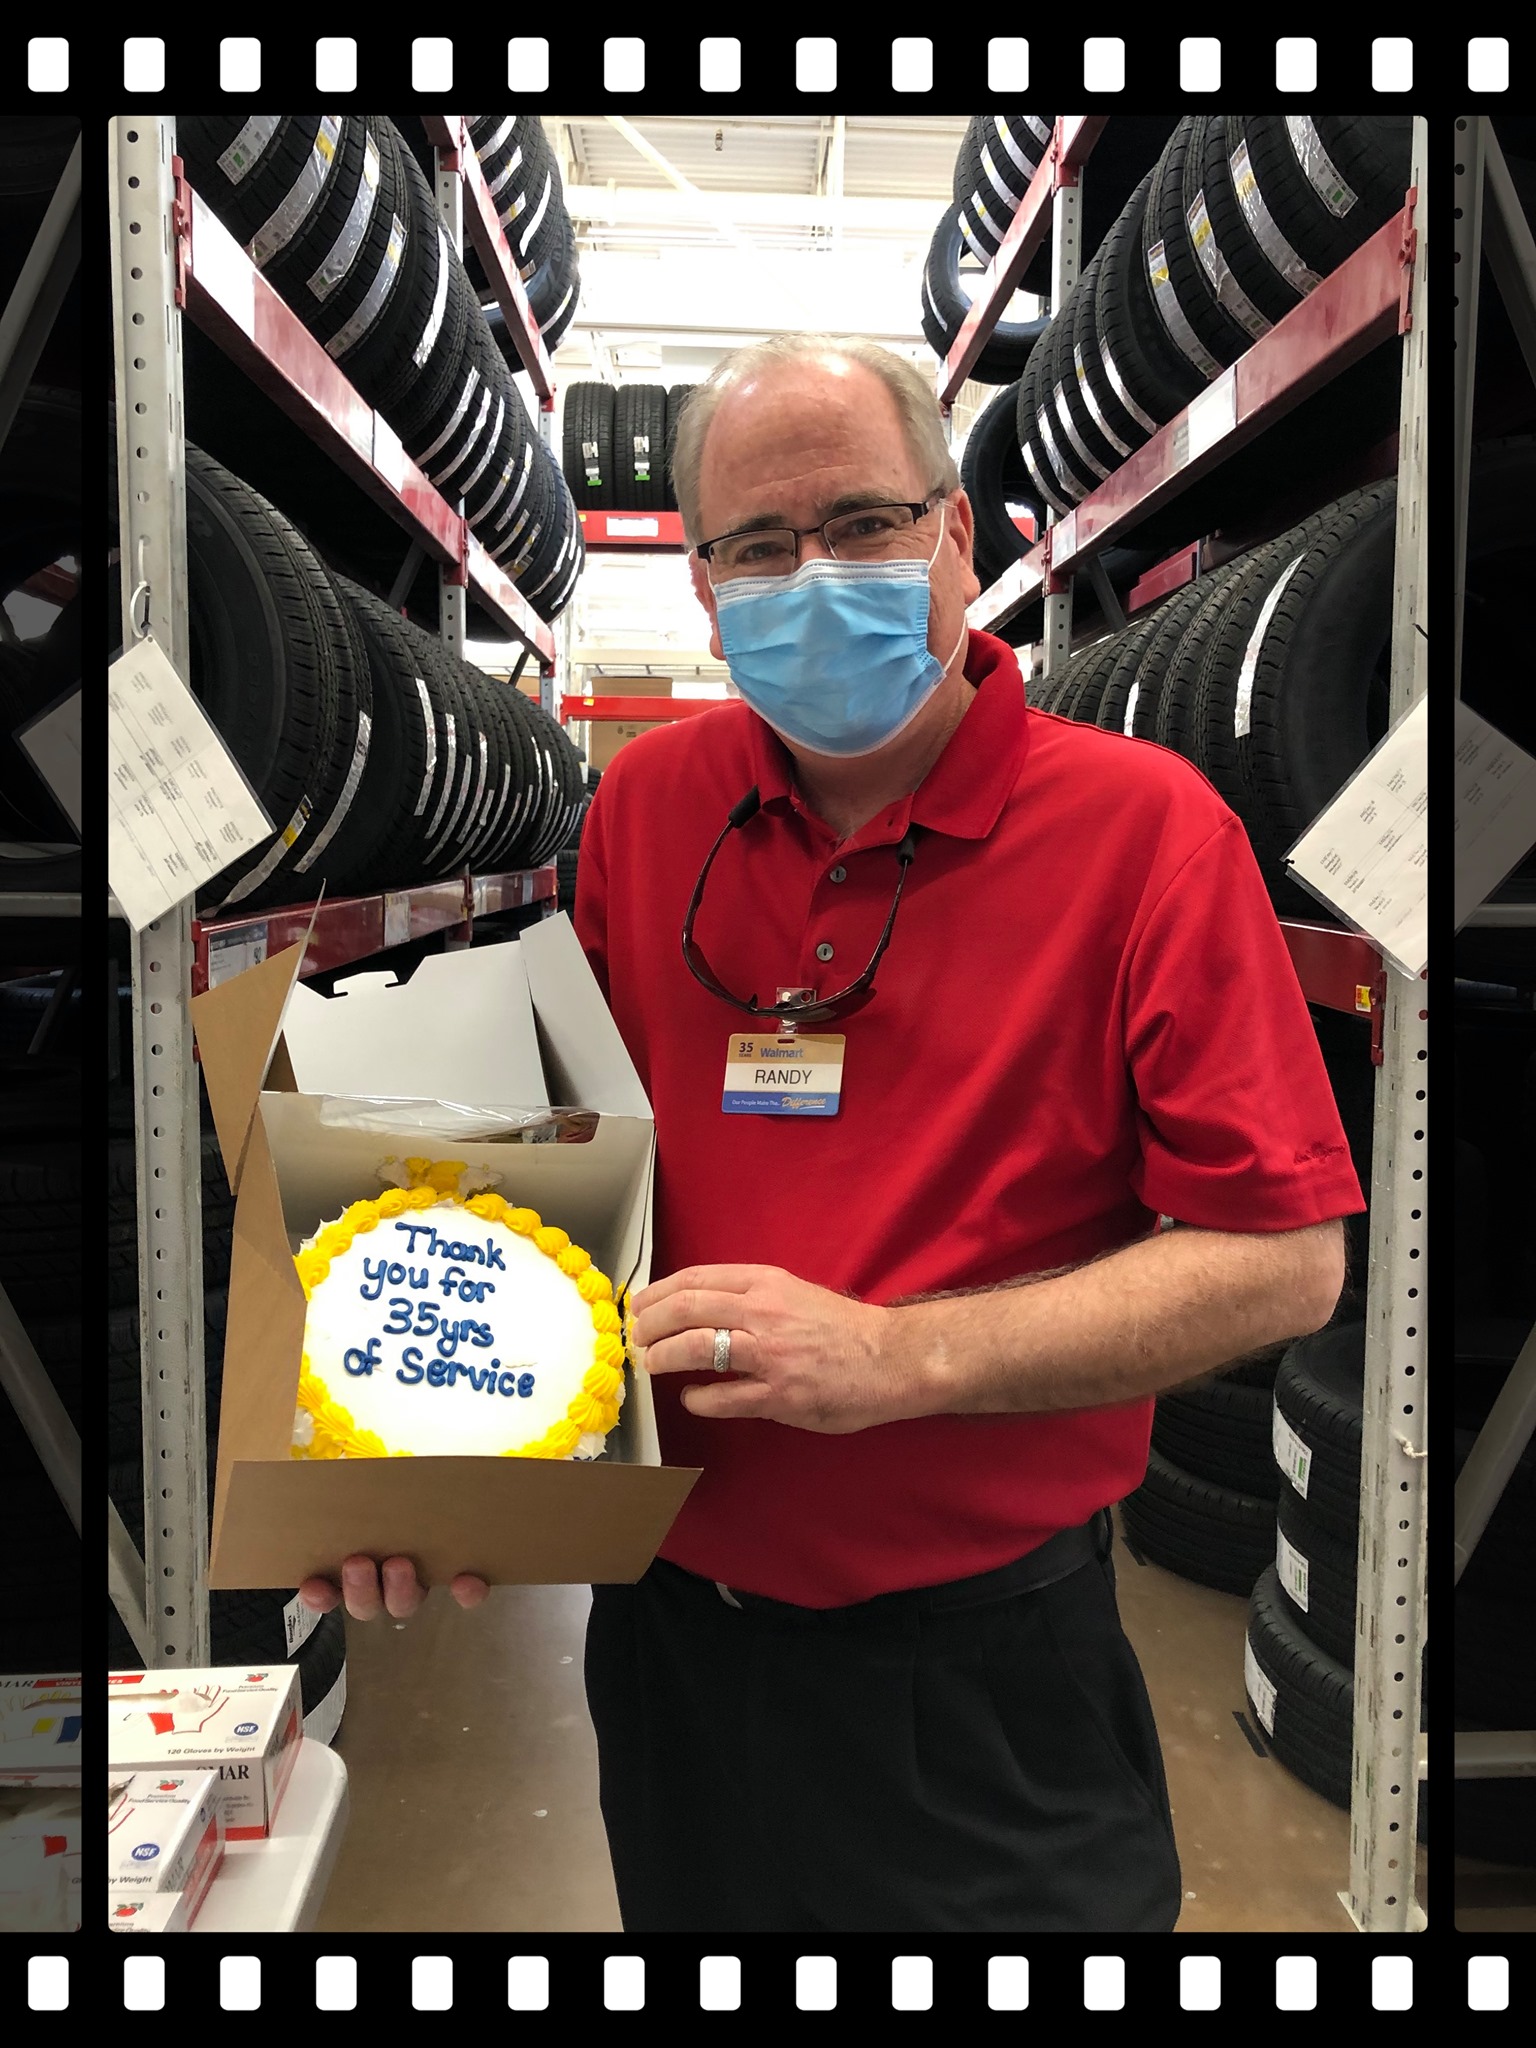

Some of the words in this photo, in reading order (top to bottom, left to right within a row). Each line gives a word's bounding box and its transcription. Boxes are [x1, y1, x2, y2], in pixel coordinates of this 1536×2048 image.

[738, 1042, 754, 1053] 35
[760, 1047, 804, 1059] Walmart
[754, 1069, 813, 1085] RANDY
[781, 1096, 827, 1110] Difference
[394, 1221, 506, 1272] Thank
[359, 1256, 429, 1301] you
[438, 1266, 496, 1304] for
[382, 1296, 495, 1358] 35yrs
[343, 1337, 383, 1377] of
[395, 1346, 536, 1399] Service
[236, 1725, 256, 1734] NSF
[226, 1746, 256, 1754] Weight
[133, 1847, 157, 1858] NSF
[119, 1875, 153, 1885] Weight
